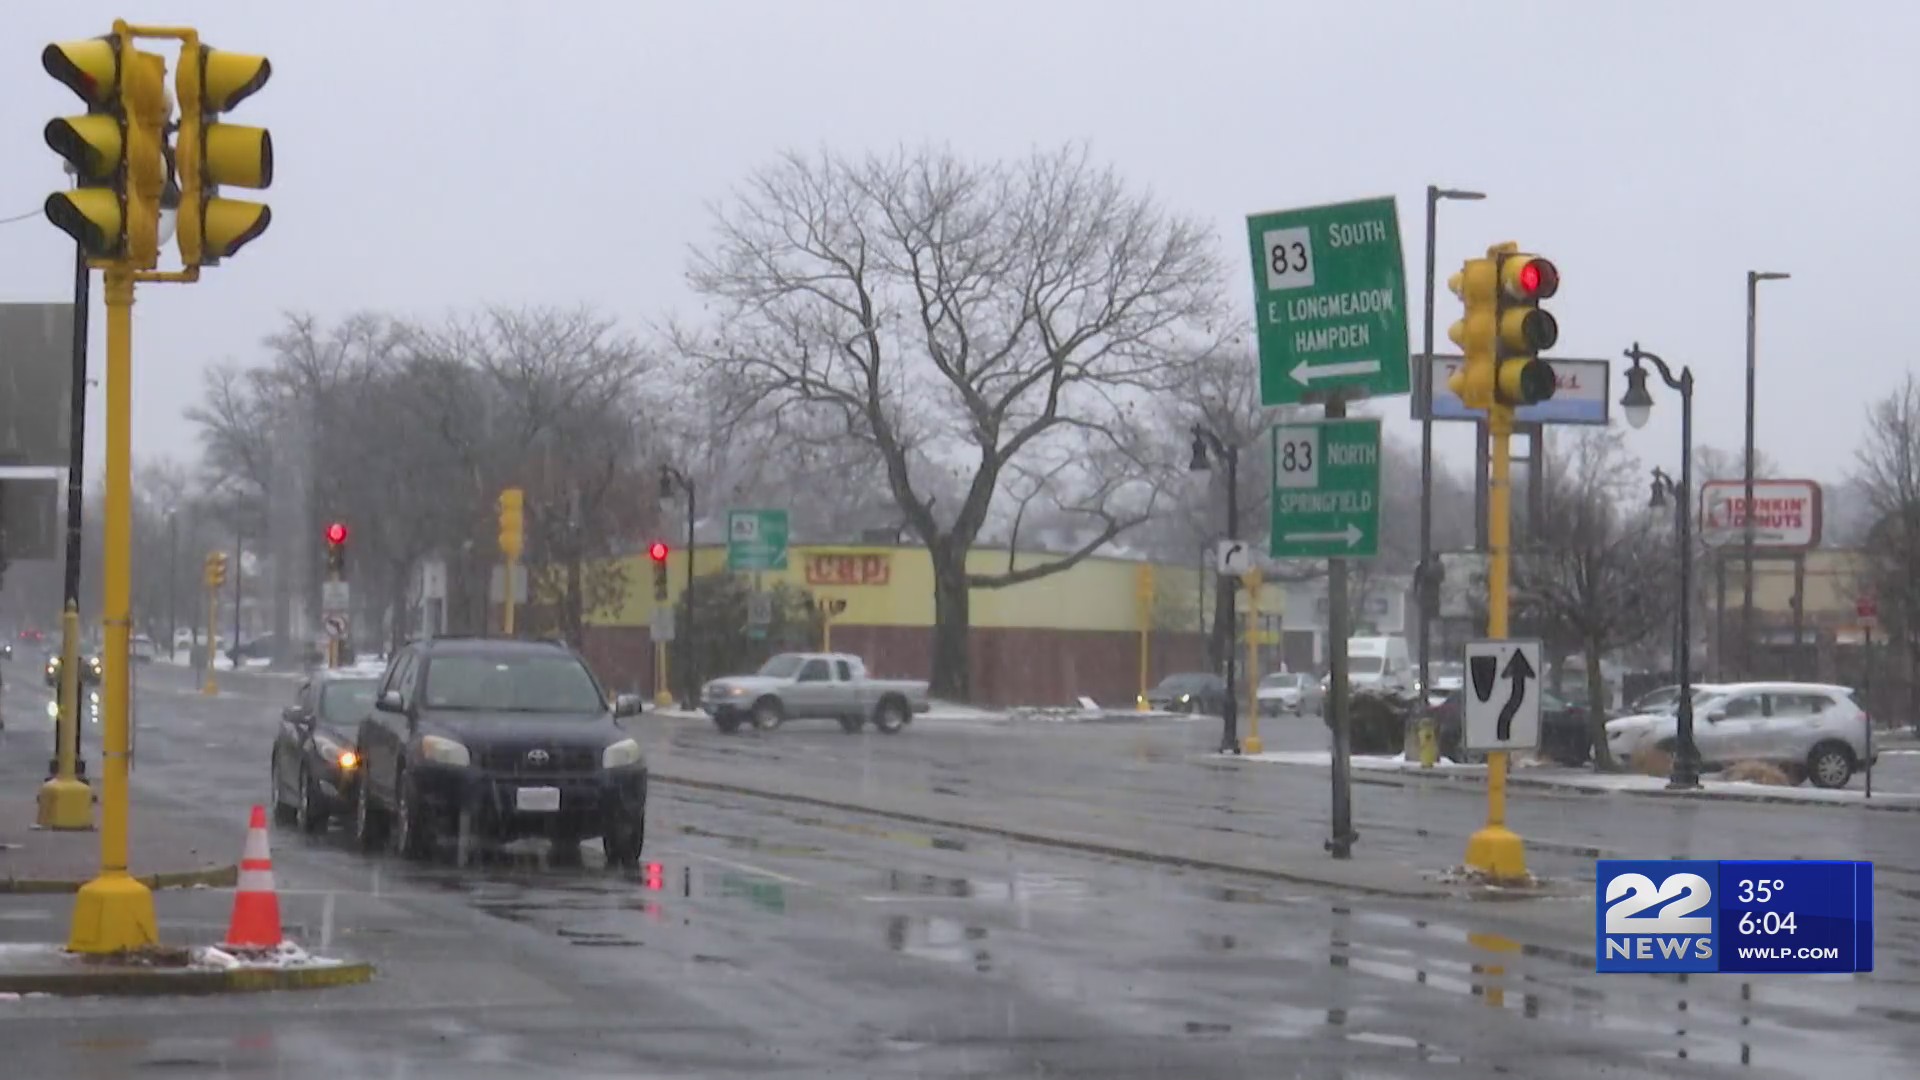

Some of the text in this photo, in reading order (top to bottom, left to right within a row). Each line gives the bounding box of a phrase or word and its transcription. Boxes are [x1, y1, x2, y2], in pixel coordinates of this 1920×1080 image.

[1271, 220, 1386, 275] 83 SOUTH
[1287, 289, 1394, 321] LONGMEADOW
[1295, 324, 1370, 352] HAMPDEN
[1282, 441, 1377, 472] 83 NORTH
[1279, 491, 1372, 513] SPRINGFIELD
[1734, 514, 1802, 528] DNUTS
